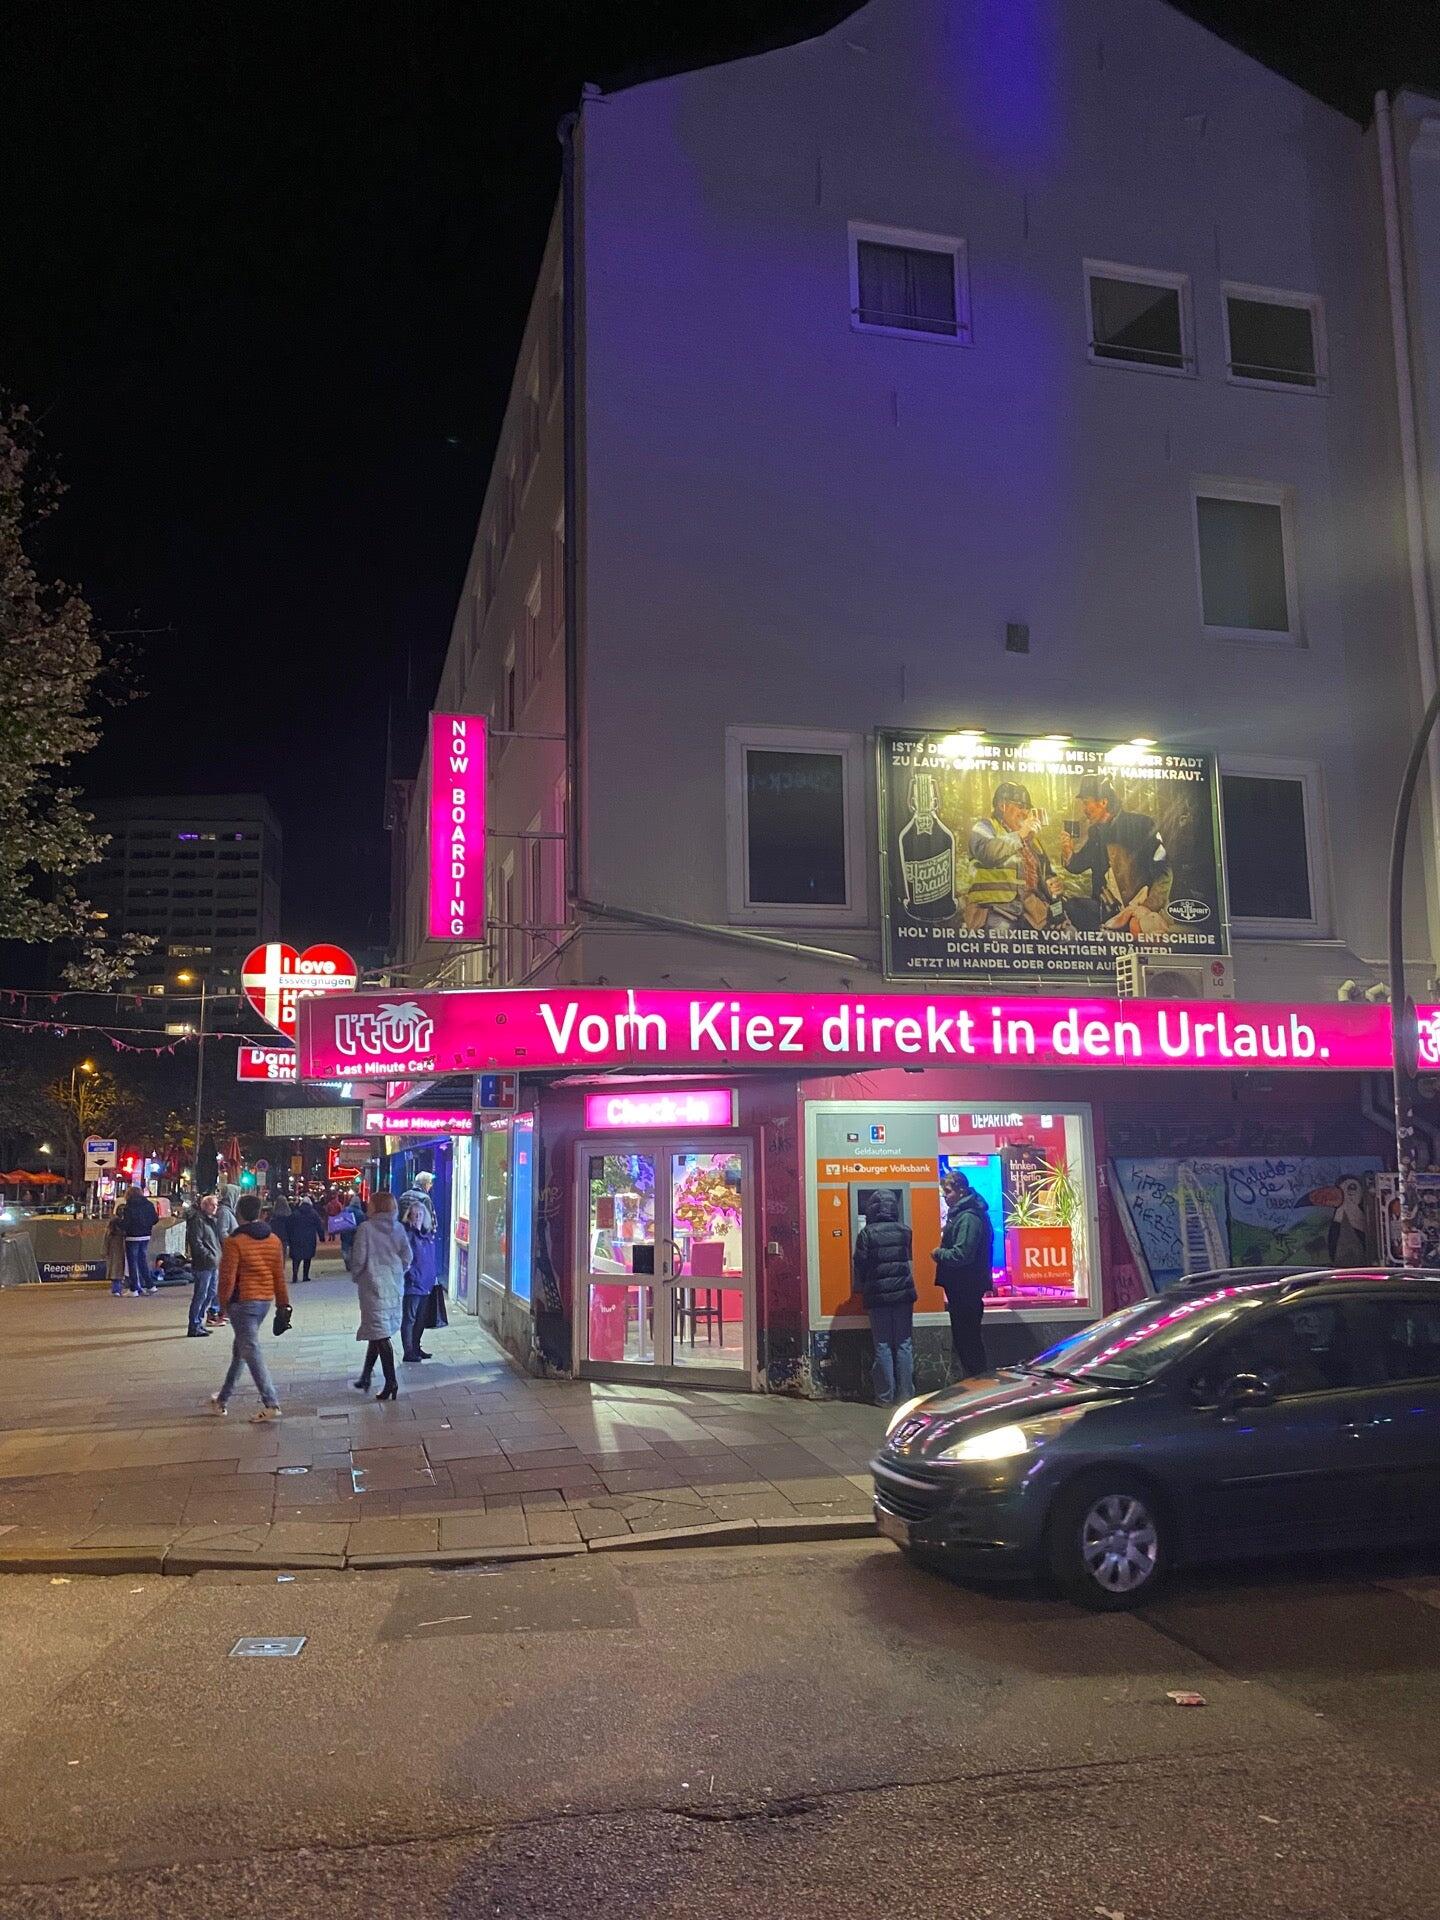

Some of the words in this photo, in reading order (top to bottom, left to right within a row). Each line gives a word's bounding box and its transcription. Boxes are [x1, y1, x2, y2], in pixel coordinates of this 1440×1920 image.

[449, 719, 469, 774] NOW
[892, 742, 924, 753] IST'S
[1165, 756, 1204, 768] STADT
[892, 756, 910, 766] ZU
[913, 757, 951, 770] LAUT,
[1002, 764, 1016, 772] IN
[1047, 764, 1084, 776] WALD
[1121, 767, 1205, 782] HANSEKRAUT.
[450, 788, 467, 936] BOARDING
[898, 927, 928, 938] HOL'
[932, 928, 955, 938] DIR
[959, 928, 985, 939] DAS
[989, 929, 1039, 940] ELIXIER
[1042, 930, 1071, 941] VOM
[1074, 931, 1104, 942] KIEZ
[1107, 931, 1134, 943] UND
[1137, 933, 1216, 945] ENTSCHEIDE
[947, 942, 980, 953] DICH
[983, 940, 1009, 954] FÜR
[1012, 944, 1034, 954] DIE
[1036, 944, 1107, 956] RICHTIGEN
[283, 956, 290, 974] I
[294, 956, 337, 974] love
[907, 958, 944, 968] JETZT
[946, 958, 960, 968] IM
[963, 958, 1010, 969] HANDEL
[1013, 960, 1044, 969] ODER
[1047, 960, 1094, 970] ORDERN
[1212, 978, 1224, 987] LG
[540, 1002, 667, 1054] Vom
[690, 1001, 804, 1051] Kiez
[822, 1005, 975, 1053] direkt
[992, 1006, 1036, 1055] in
[1052, 1008, 1142, 1057] den
[1158, 1010, 1330, 1058] Urlaub.
[336, 1063, 363, 1075] Last
[365, 1061, 405, 1074] Minute
[386, 1117, 409, 1128] Last
[411, 1117, 447, 1129] Minute
[854, 1147, 902, 1156] Geldautomat
[842, 1164, 888, 1175] Haburger
[889, 1163, 931, 1173] Volksbank
[1024, 1246, 1068, 1268] RIU
[43, 1263, 96, 1273] Reeperbahn
